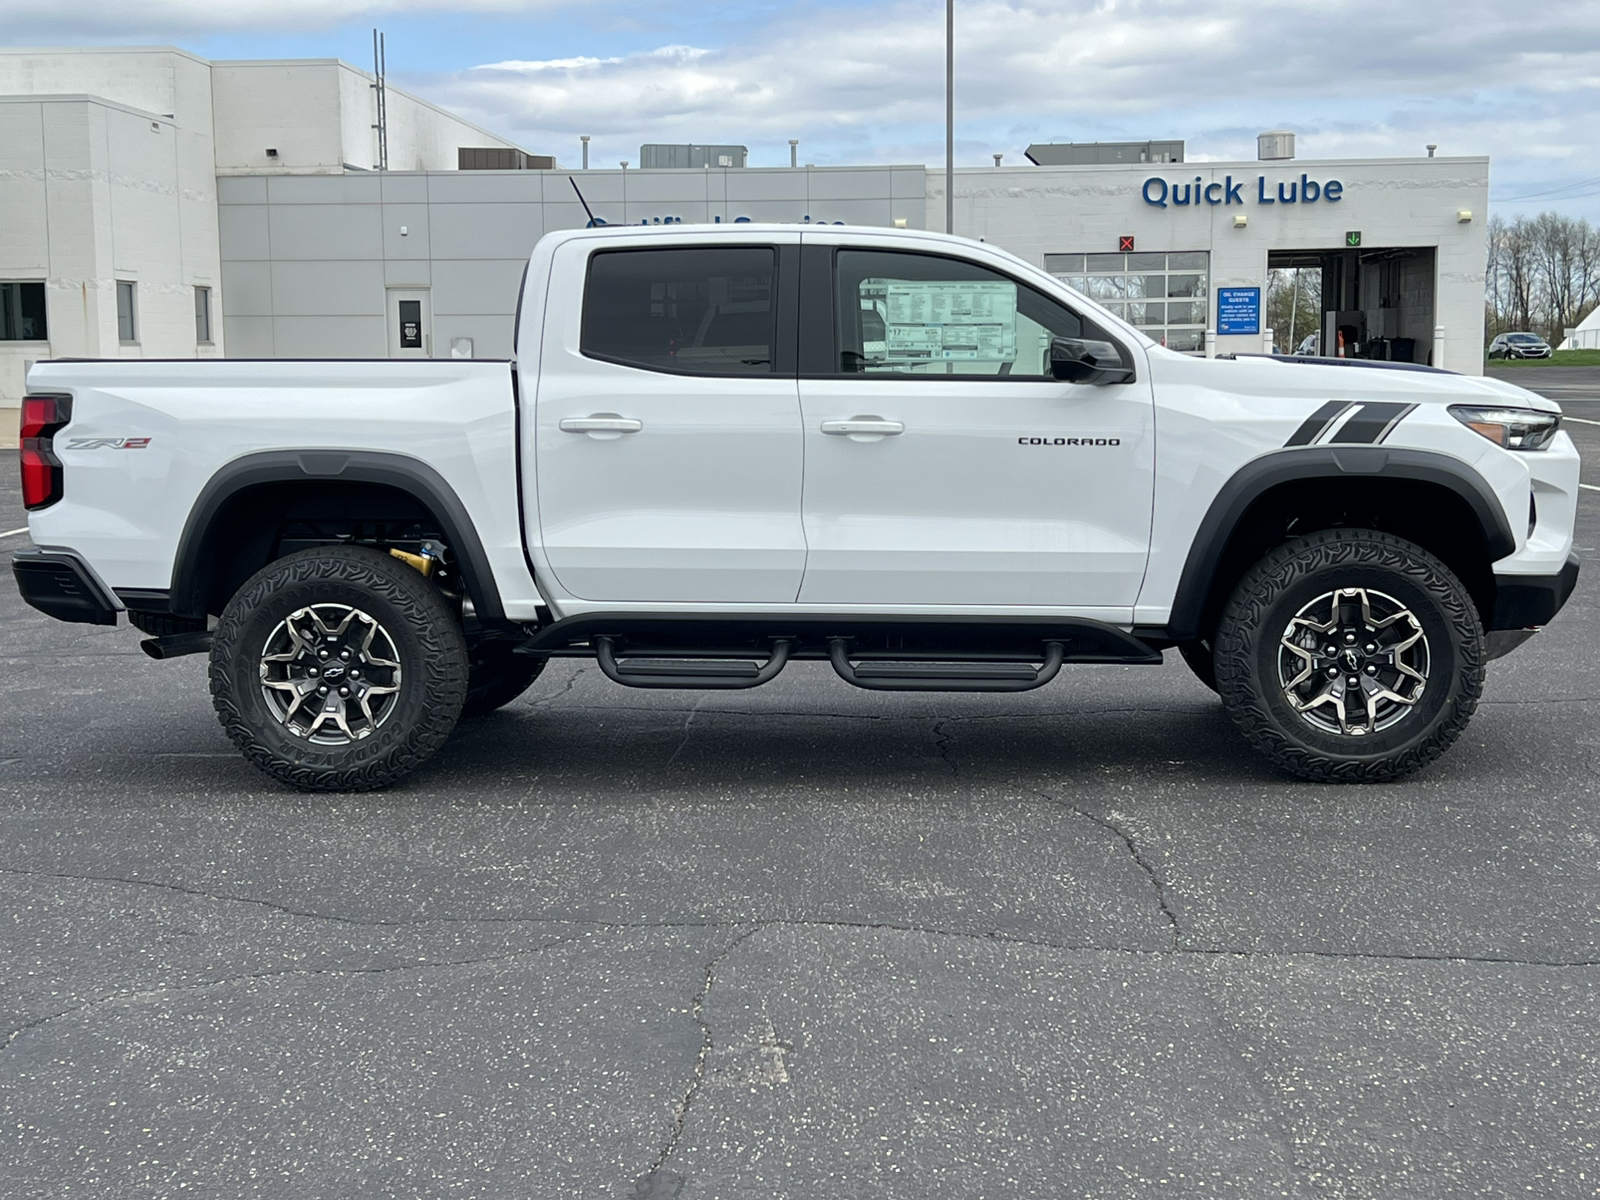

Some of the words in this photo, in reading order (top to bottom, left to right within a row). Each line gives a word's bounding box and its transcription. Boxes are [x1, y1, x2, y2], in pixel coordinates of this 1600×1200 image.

[1142, 175, 1244, 209] Quick
[1258, 174, 1343, 205] Lube
[65, 437, 152, 450] ZR2
[1018, 437, 1121, 446] COLORADO
[256, 582, 373, 625] WRANGLER
[278, 720, 404, 768] GOODYEAR
